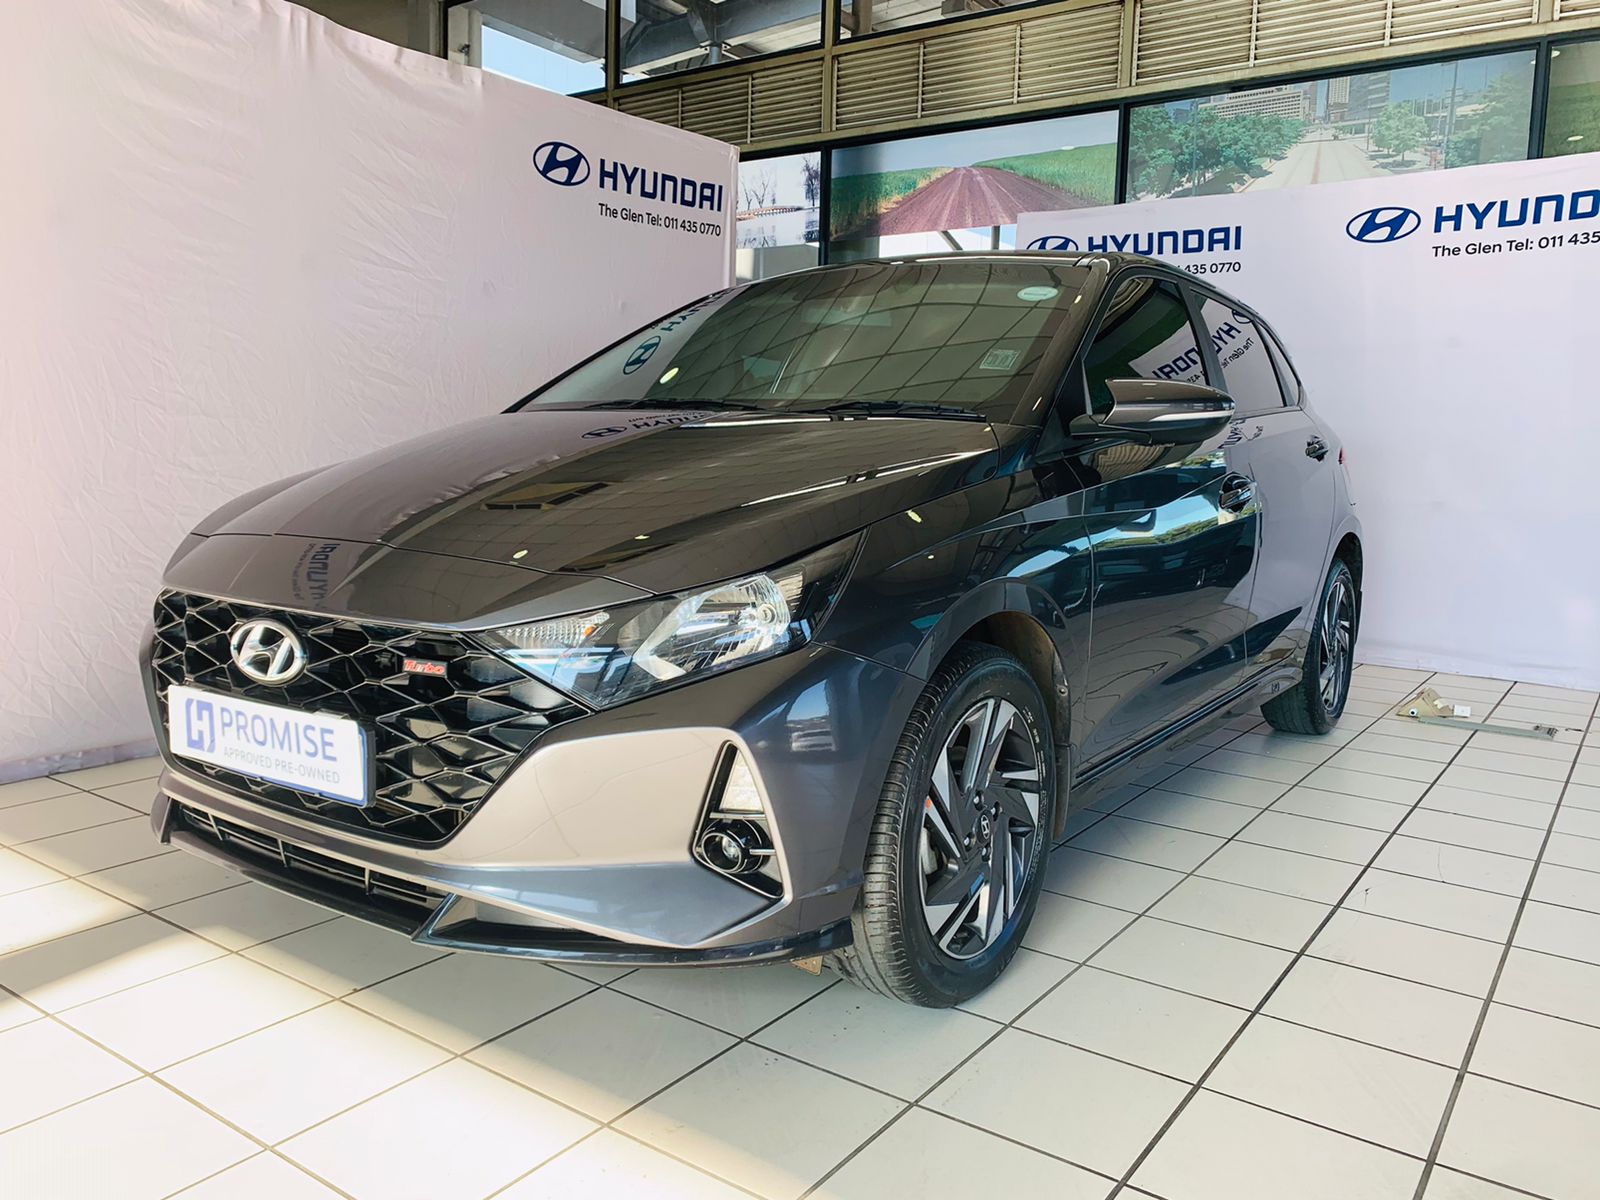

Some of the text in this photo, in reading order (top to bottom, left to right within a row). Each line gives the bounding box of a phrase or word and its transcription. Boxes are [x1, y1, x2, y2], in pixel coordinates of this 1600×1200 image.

[599, 158, 723, 212] HYUNDAI
[598, 203, 721, 237] The Glen Tel: 011 435 0770
[1087, 226, 1241, 255] HYUNDAI
[1432, 231, 1600, 257] The Glen Tel: 011 435
[1209, 261, 1242, 273] 0770
[220, 706, 337, 762] PROMISE
[224, 746, 340, 784] APPROVED PRE-OWNED
